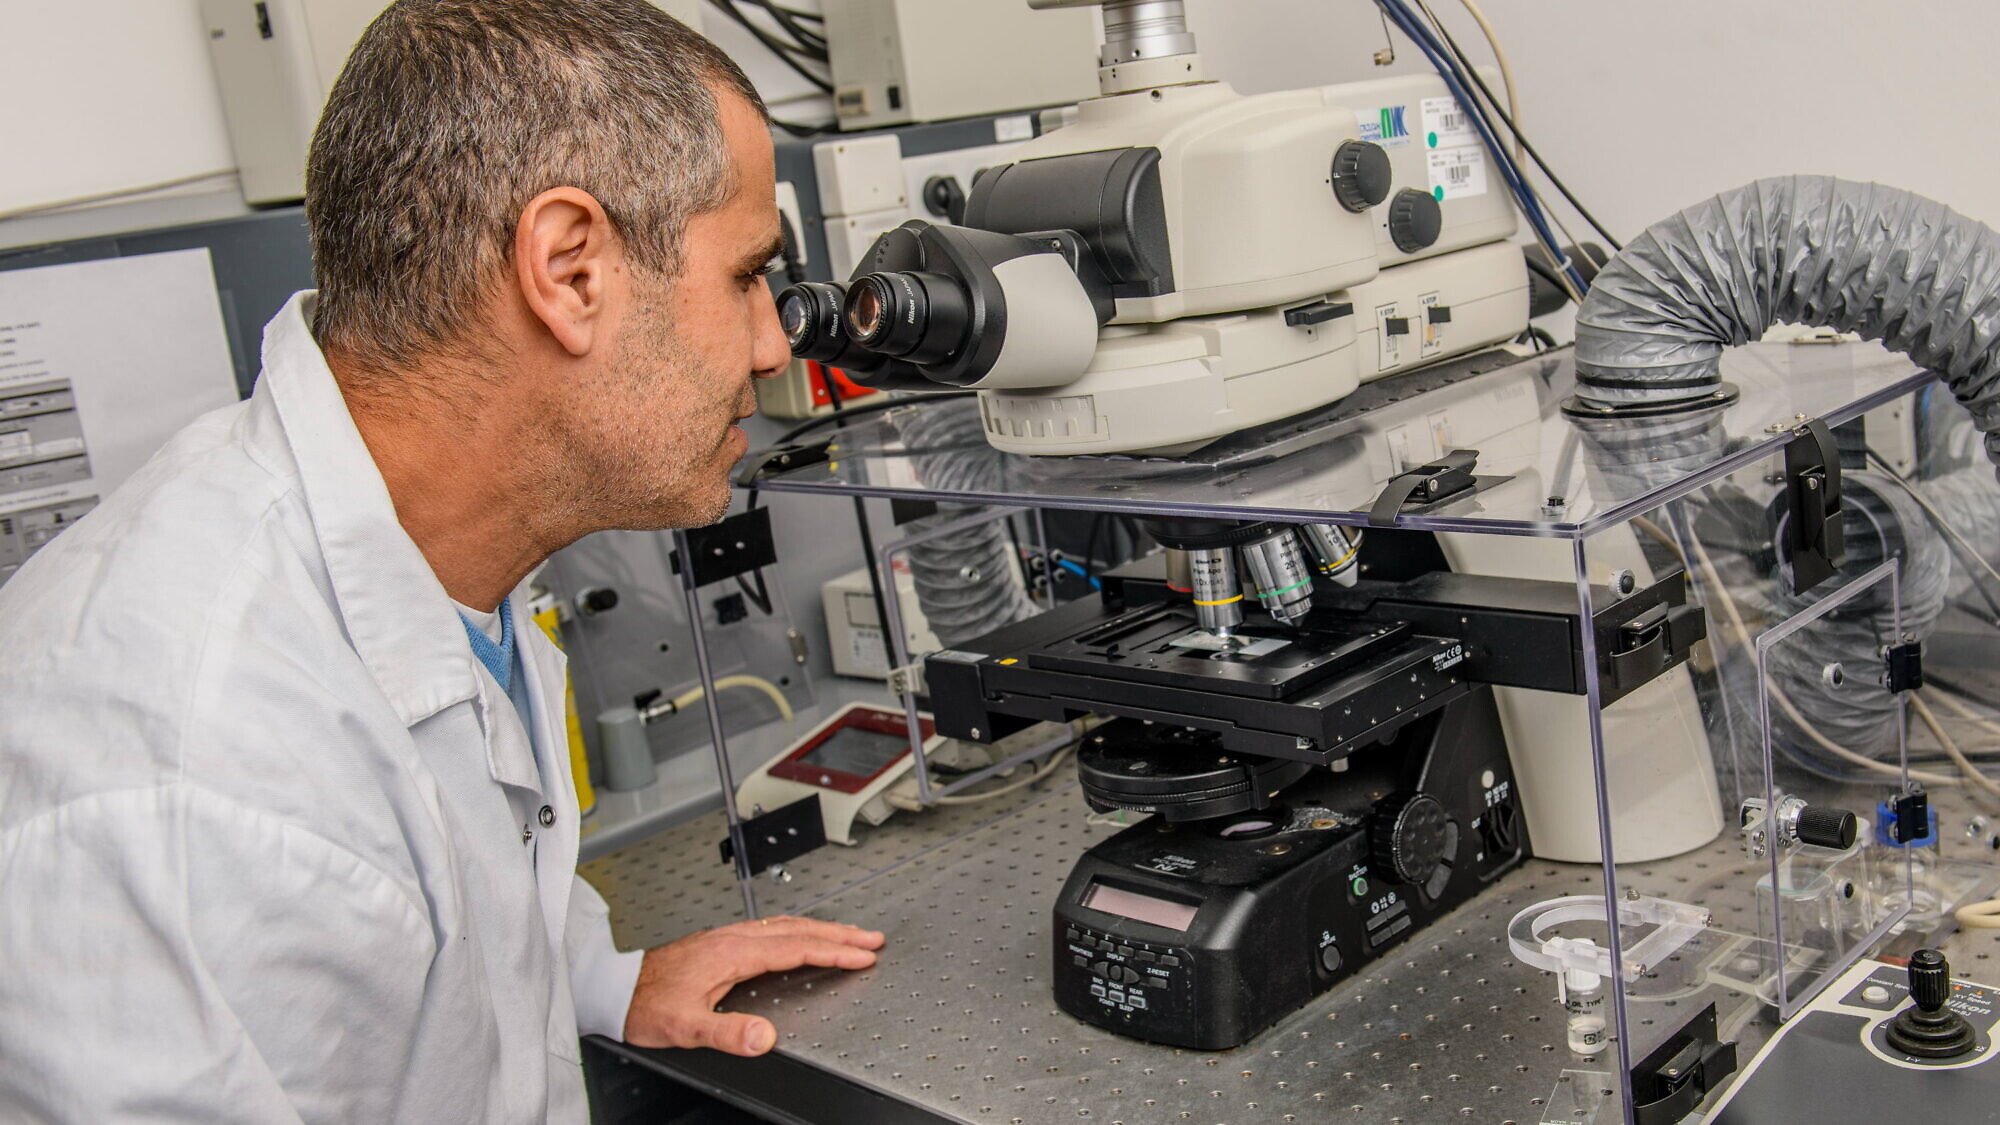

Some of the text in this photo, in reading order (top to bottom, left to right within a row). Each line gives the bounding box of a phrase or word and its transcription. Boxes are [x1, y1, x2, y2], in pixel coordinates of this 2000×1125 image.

[827, 291, 839, 337] Nikon JAPAN
[901, 278, 916, 324] Nikon JAPAN
